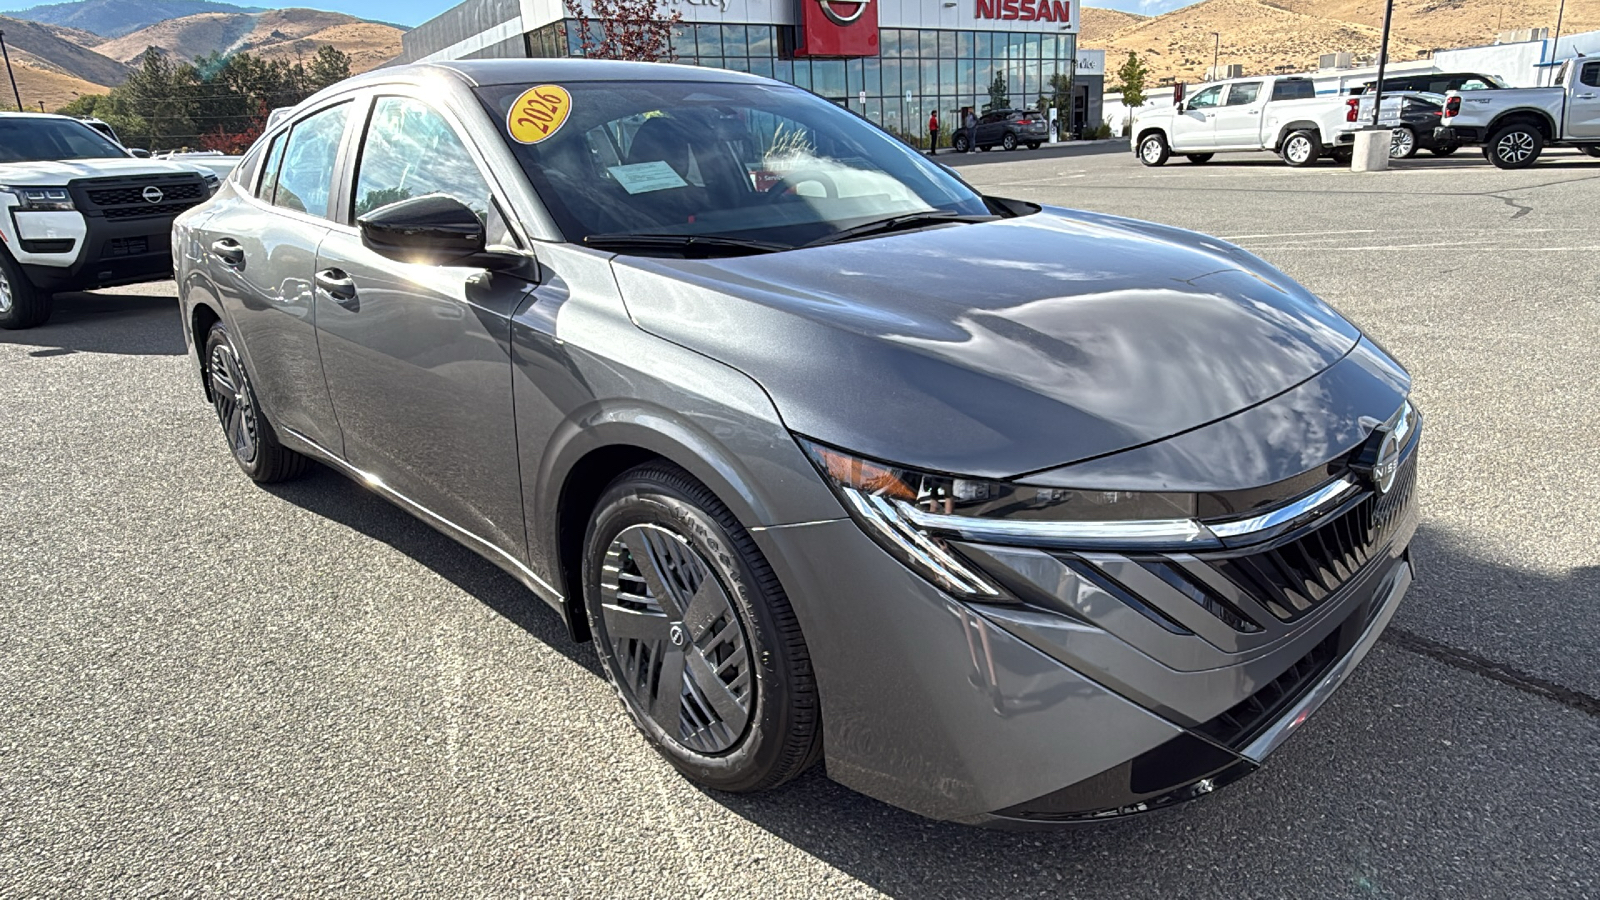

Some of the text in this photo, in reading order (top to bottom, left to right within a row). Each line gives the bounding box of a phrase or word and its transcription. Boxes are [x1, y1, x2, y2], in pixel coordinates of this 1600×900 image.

[976, 0, 1070, 22] NISSAN
[1074, 58, 1097, 69] ervice
[518, 90, 562, 134] 2026
[1375, 459, 1397, 479] NISS
